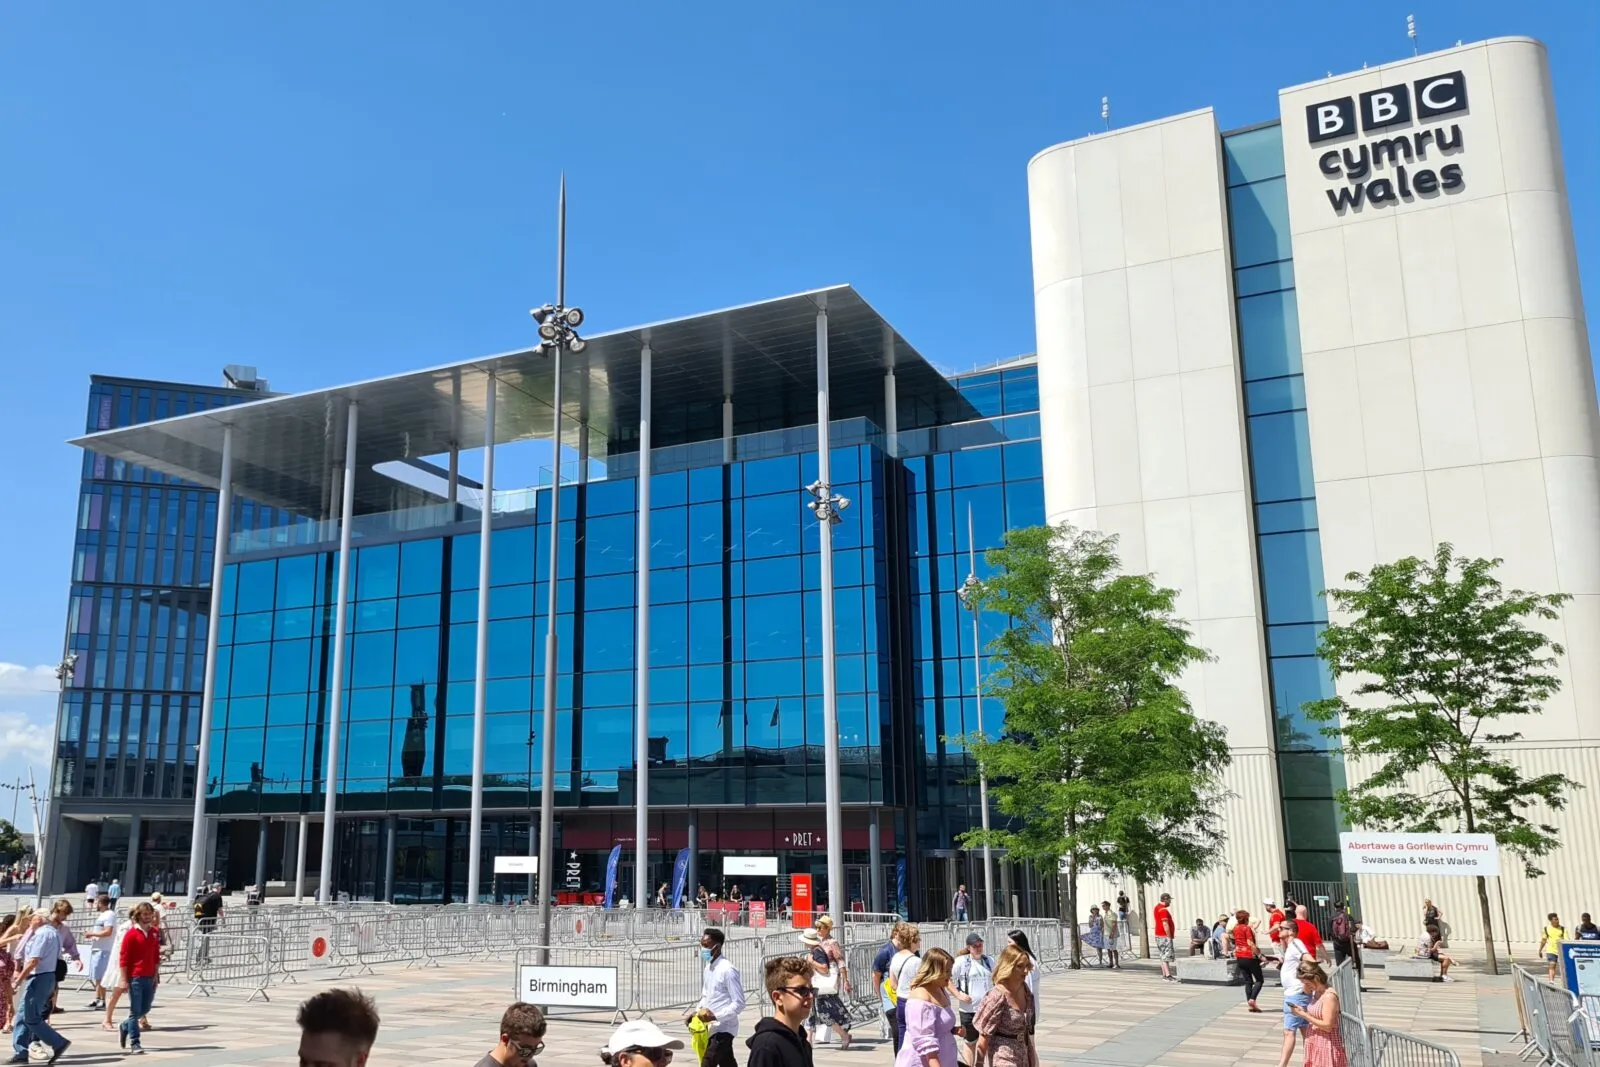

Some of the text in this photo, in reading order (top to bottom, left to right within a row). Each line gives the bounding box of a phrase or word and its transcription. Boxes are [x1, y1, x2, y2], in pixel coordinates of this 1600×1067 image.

[1317, 78, 1457, 136] BBC
[1318, 123, 1462, 180] cymru
[1325, 163, 1464, 212] wales
[793, 832, 813, 846] PRET
[1348, 841, 1396, 850] Abertawe
[1405, 841, 1454, 851] Gorllewin
[1455, 842, 1489, 853] Cymru
[1361, 856, 1478, 866] Swansea & West Wales
[566, 862, 581, 889] PRET
[529, 978, 607, 996] Birmingham
